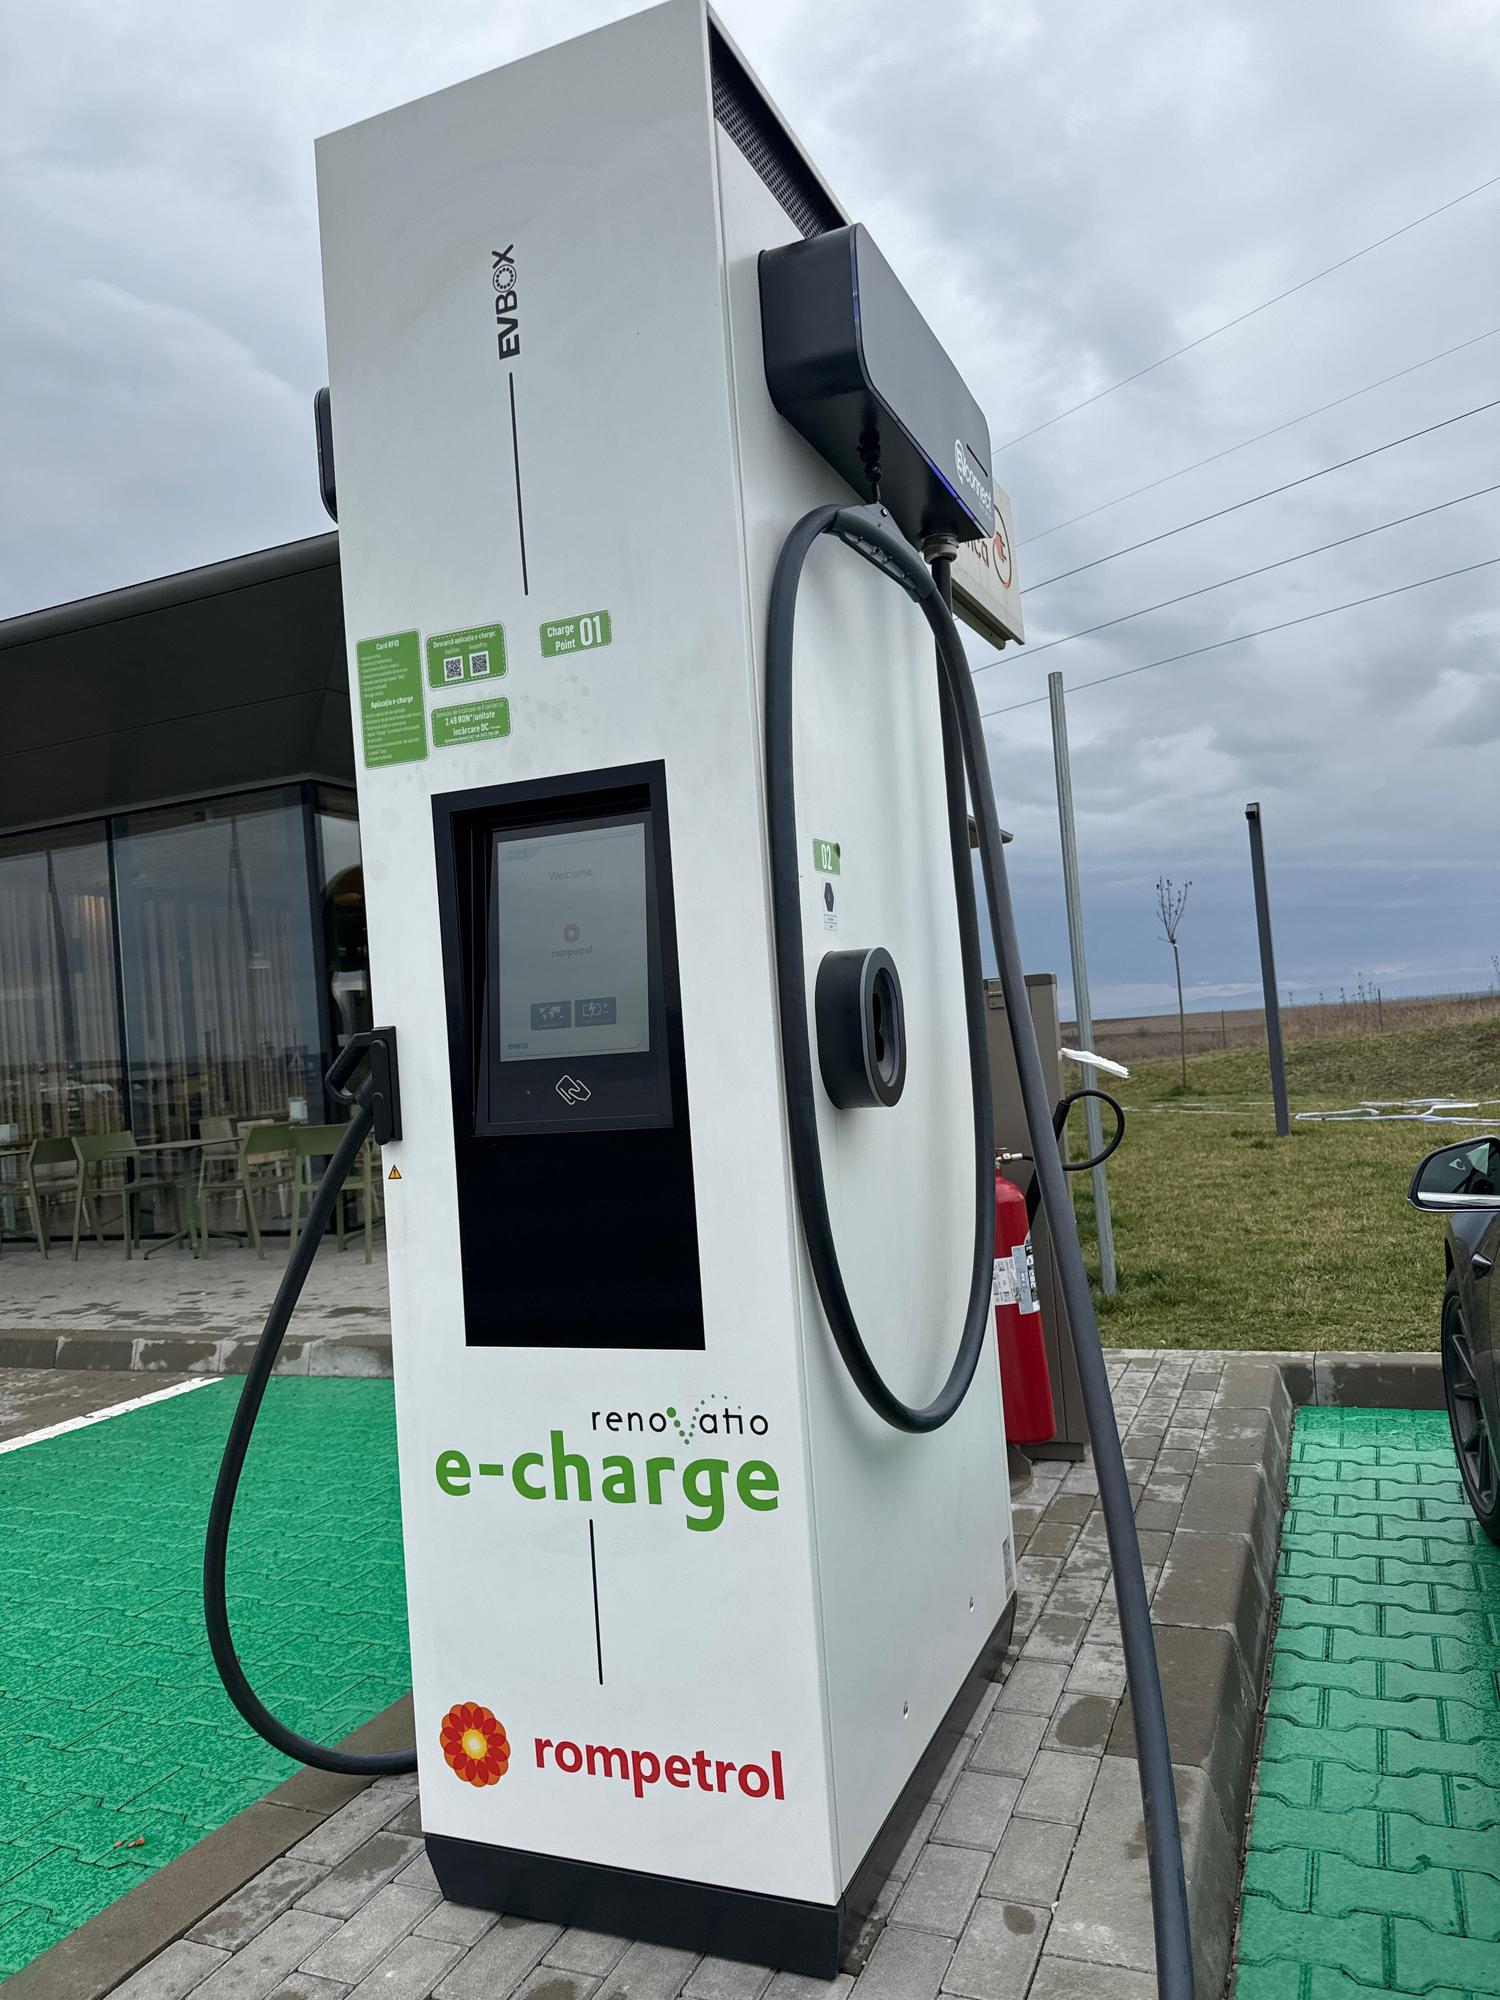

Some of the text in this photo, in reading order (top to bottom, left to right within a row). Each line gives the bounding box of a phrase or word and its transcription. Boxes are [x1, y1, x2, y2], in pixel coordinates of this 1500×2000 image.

[492, 244, 520, 360] EVBOX
[547, 624, 574, 638] Charge
[579, 615, 602, 646] 01
[555, 638, 576, 652] Point
[480, 723, 489, 732] DC
[821, 843, 832, 871] 02
[549, 868, 593, 881] Welcome
[551, 945, 593, 958] rompetrol
[435, 1430, 780, 1532] e-charge
[534, 1737, 785, 1800] rompetrol
